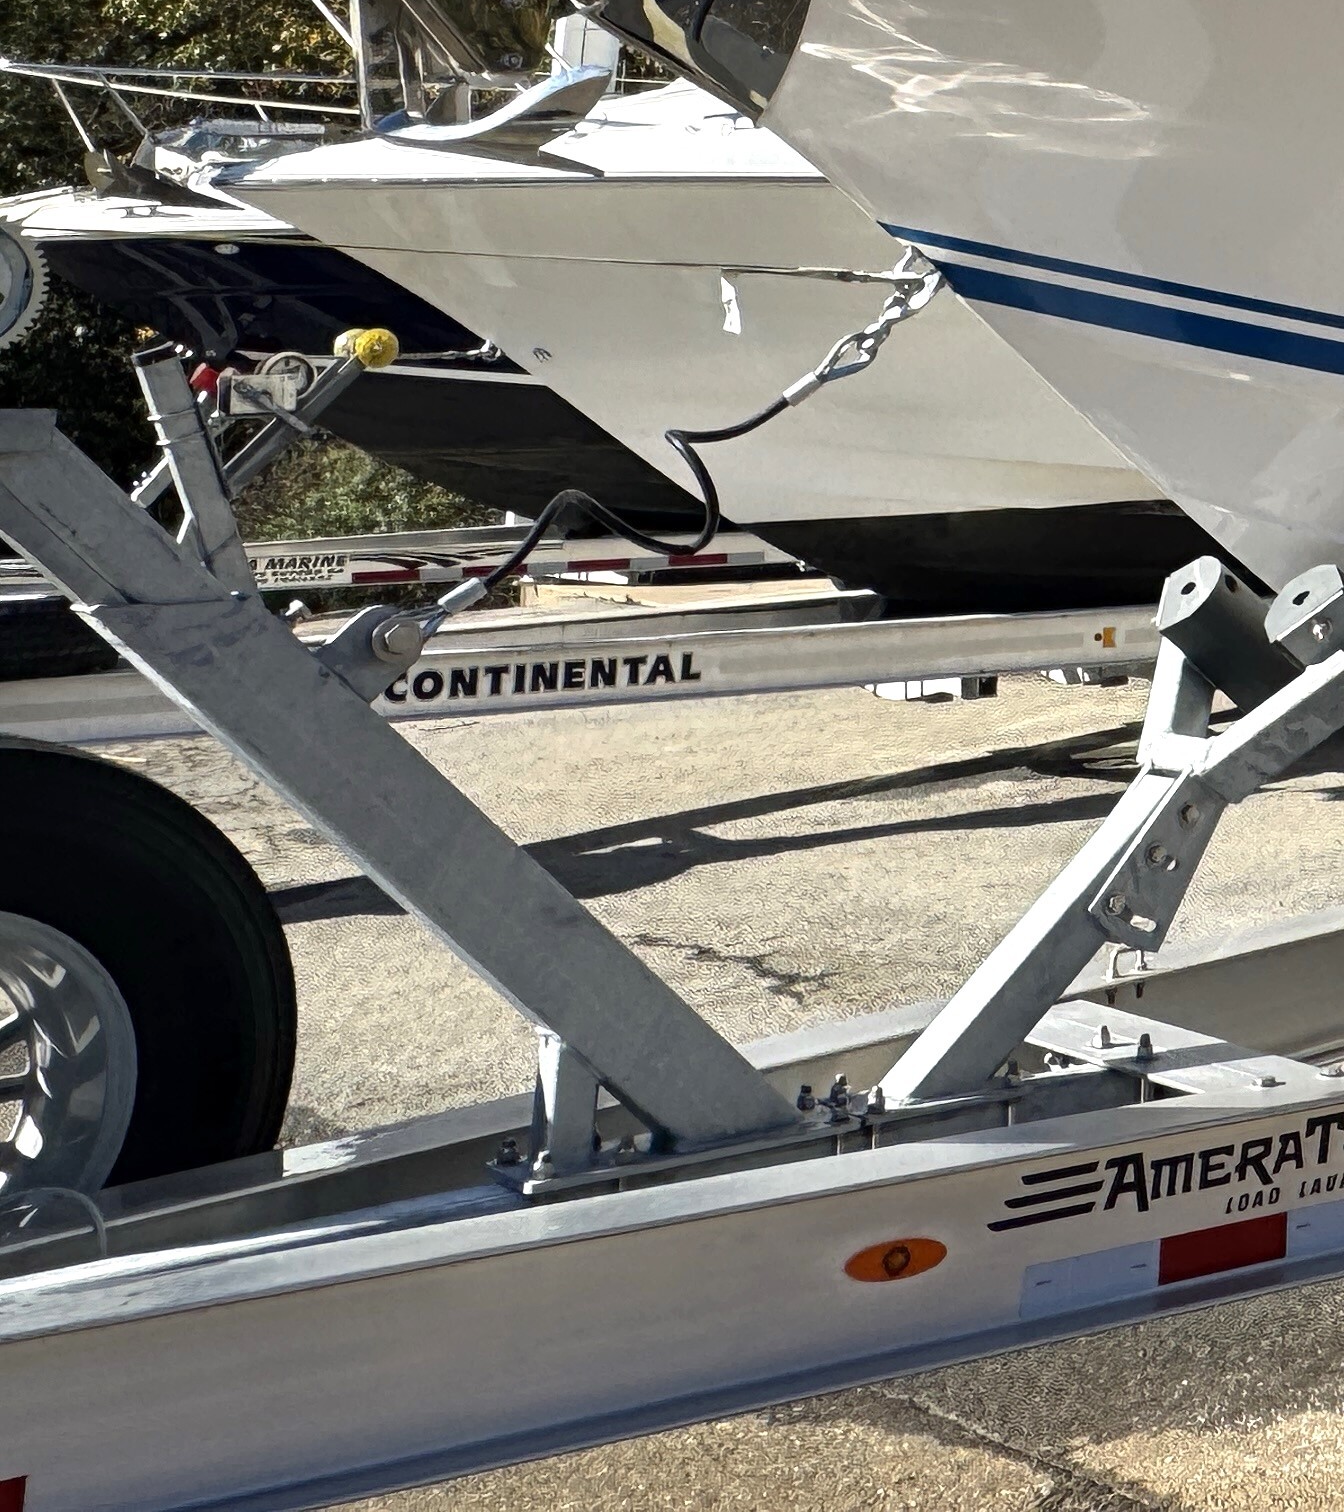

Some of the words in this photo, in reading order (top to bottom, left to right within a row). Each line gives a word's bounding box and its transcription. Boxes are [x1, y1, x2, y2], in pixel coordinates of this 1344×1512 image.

[265, 554, 347, 570] MARINE
[384, 651, 702, 703] CONTINENTAL
[1225, 1187, 1281, 1214] LOAD
